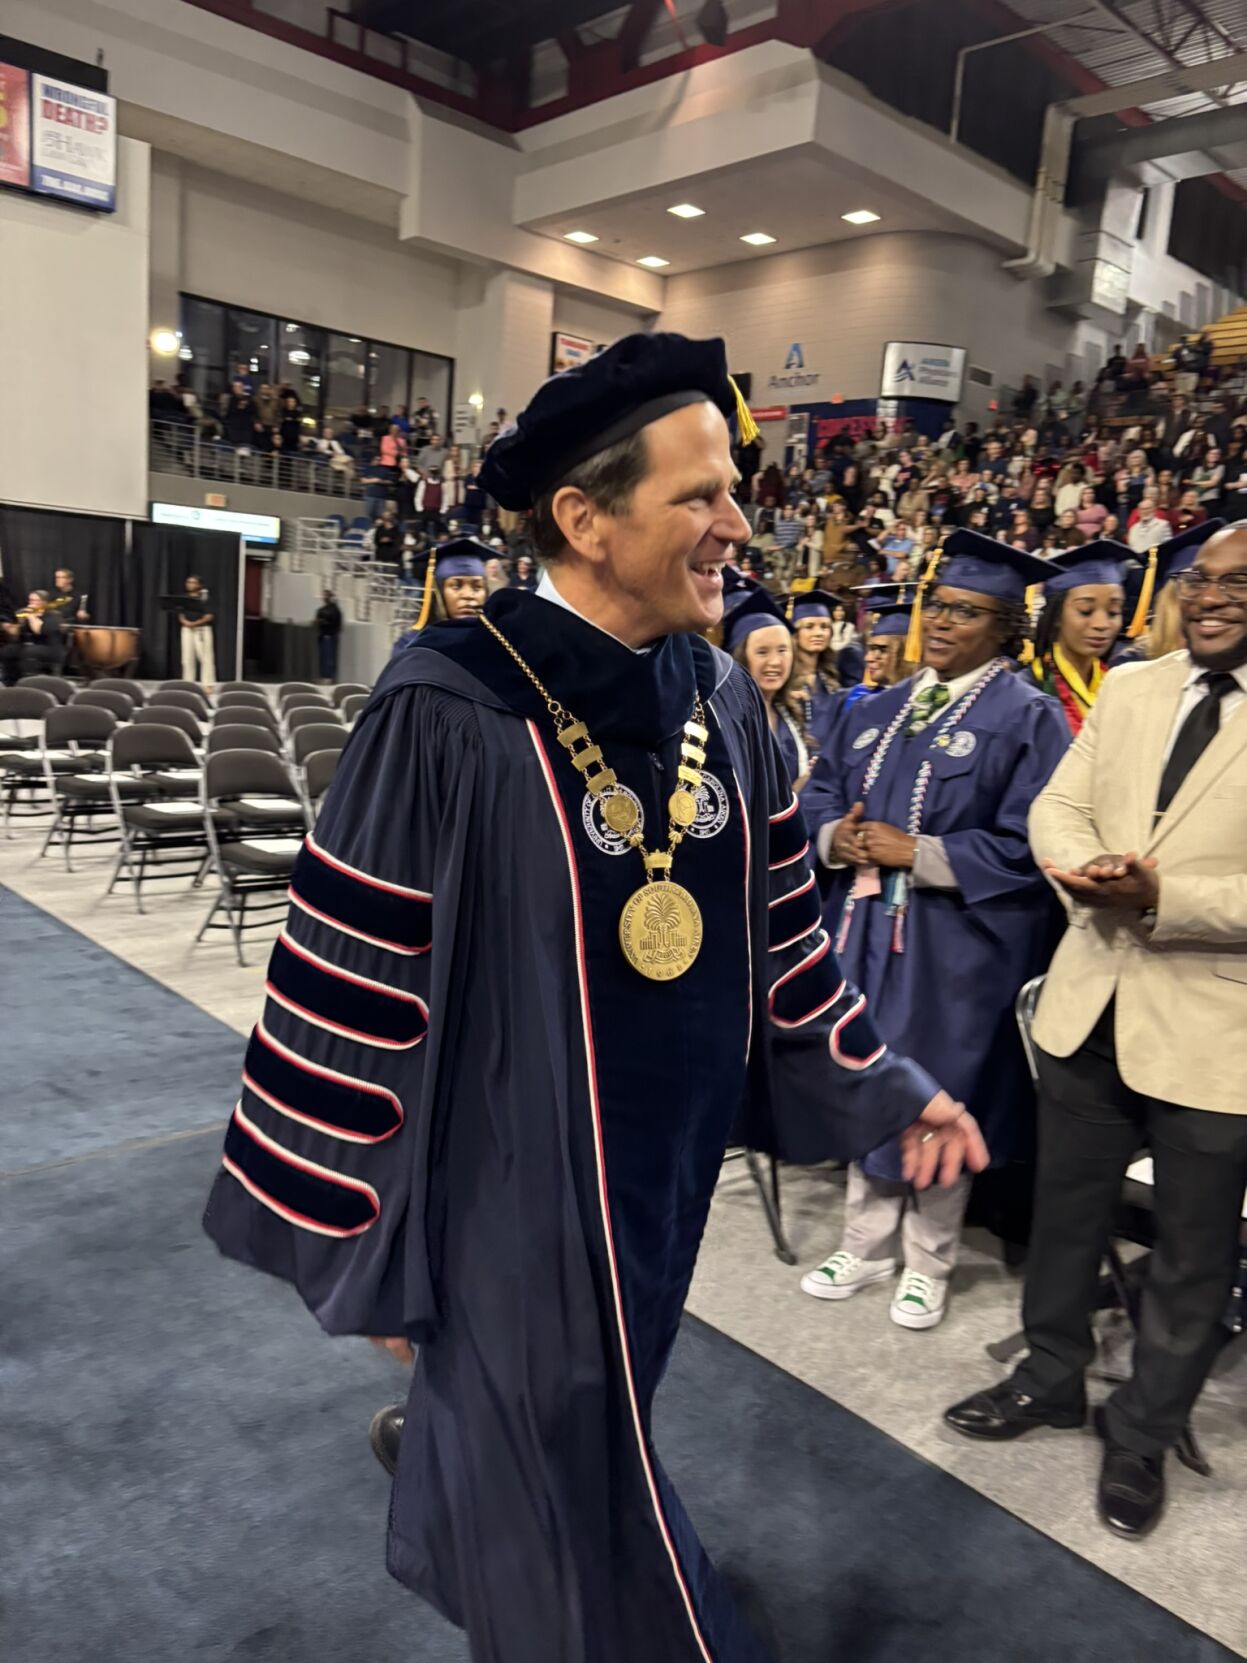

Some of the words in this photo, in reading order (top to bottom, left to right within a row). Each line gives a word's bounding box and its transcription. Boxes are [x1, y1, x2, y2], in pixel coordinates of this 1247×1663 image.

[41, 83, 108, 116] WRONGFUL
[41, 99, 108, 135] DEATH?
[768, 372, 820, 390] Anchor
[623, 904, 638, 965] UNIVERSITY
